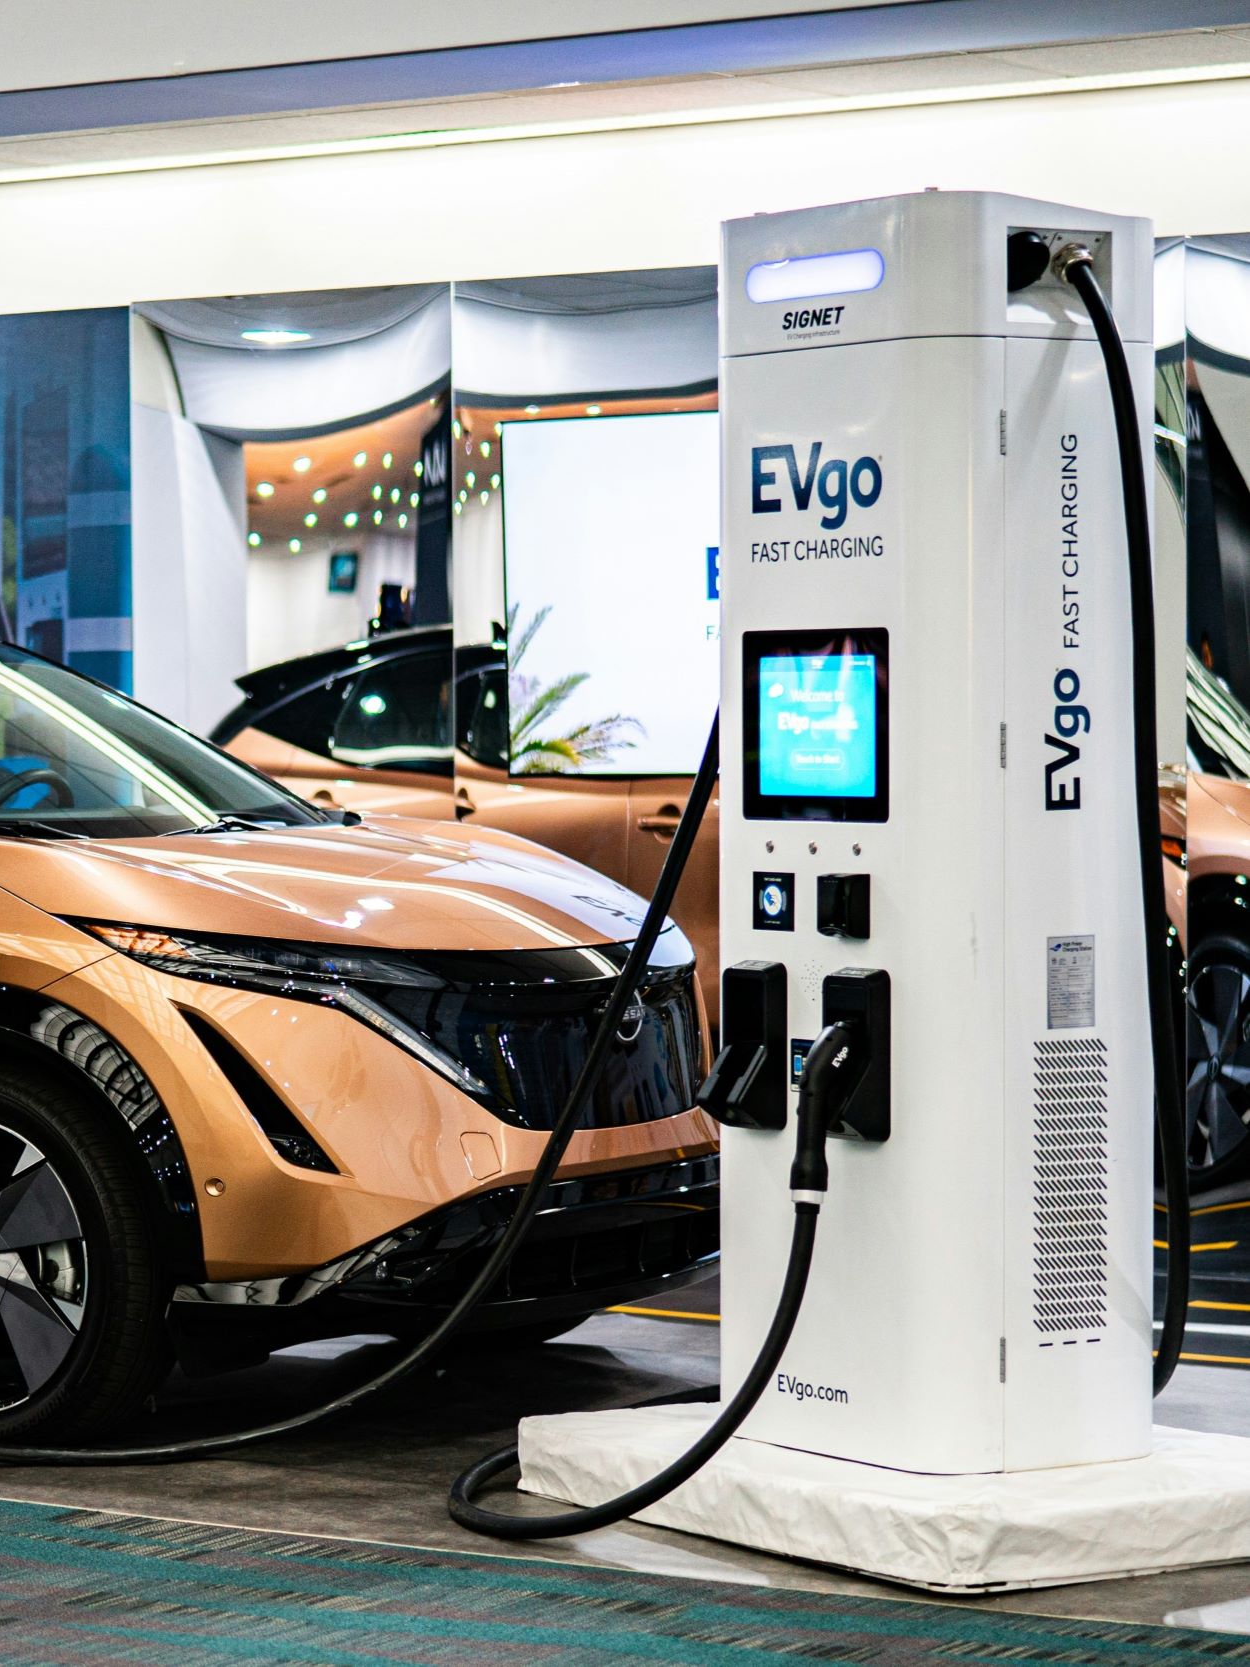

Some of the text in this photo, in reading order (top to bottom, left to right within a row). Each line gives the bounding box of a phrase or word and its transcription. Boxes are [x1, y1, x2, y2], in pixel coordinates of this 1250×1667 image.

[782, 306, 845, 330] SIGNET
[752, 441, 883, 530] EVgo
[751, 535, 884, 563] FAST CHARGING
[1044, 433, 1091, 811] EVgo FAST CHARGING
[831, 1046, 849, 1068] EVgo
[777, 1373, 848, 1404] EVgo.com
